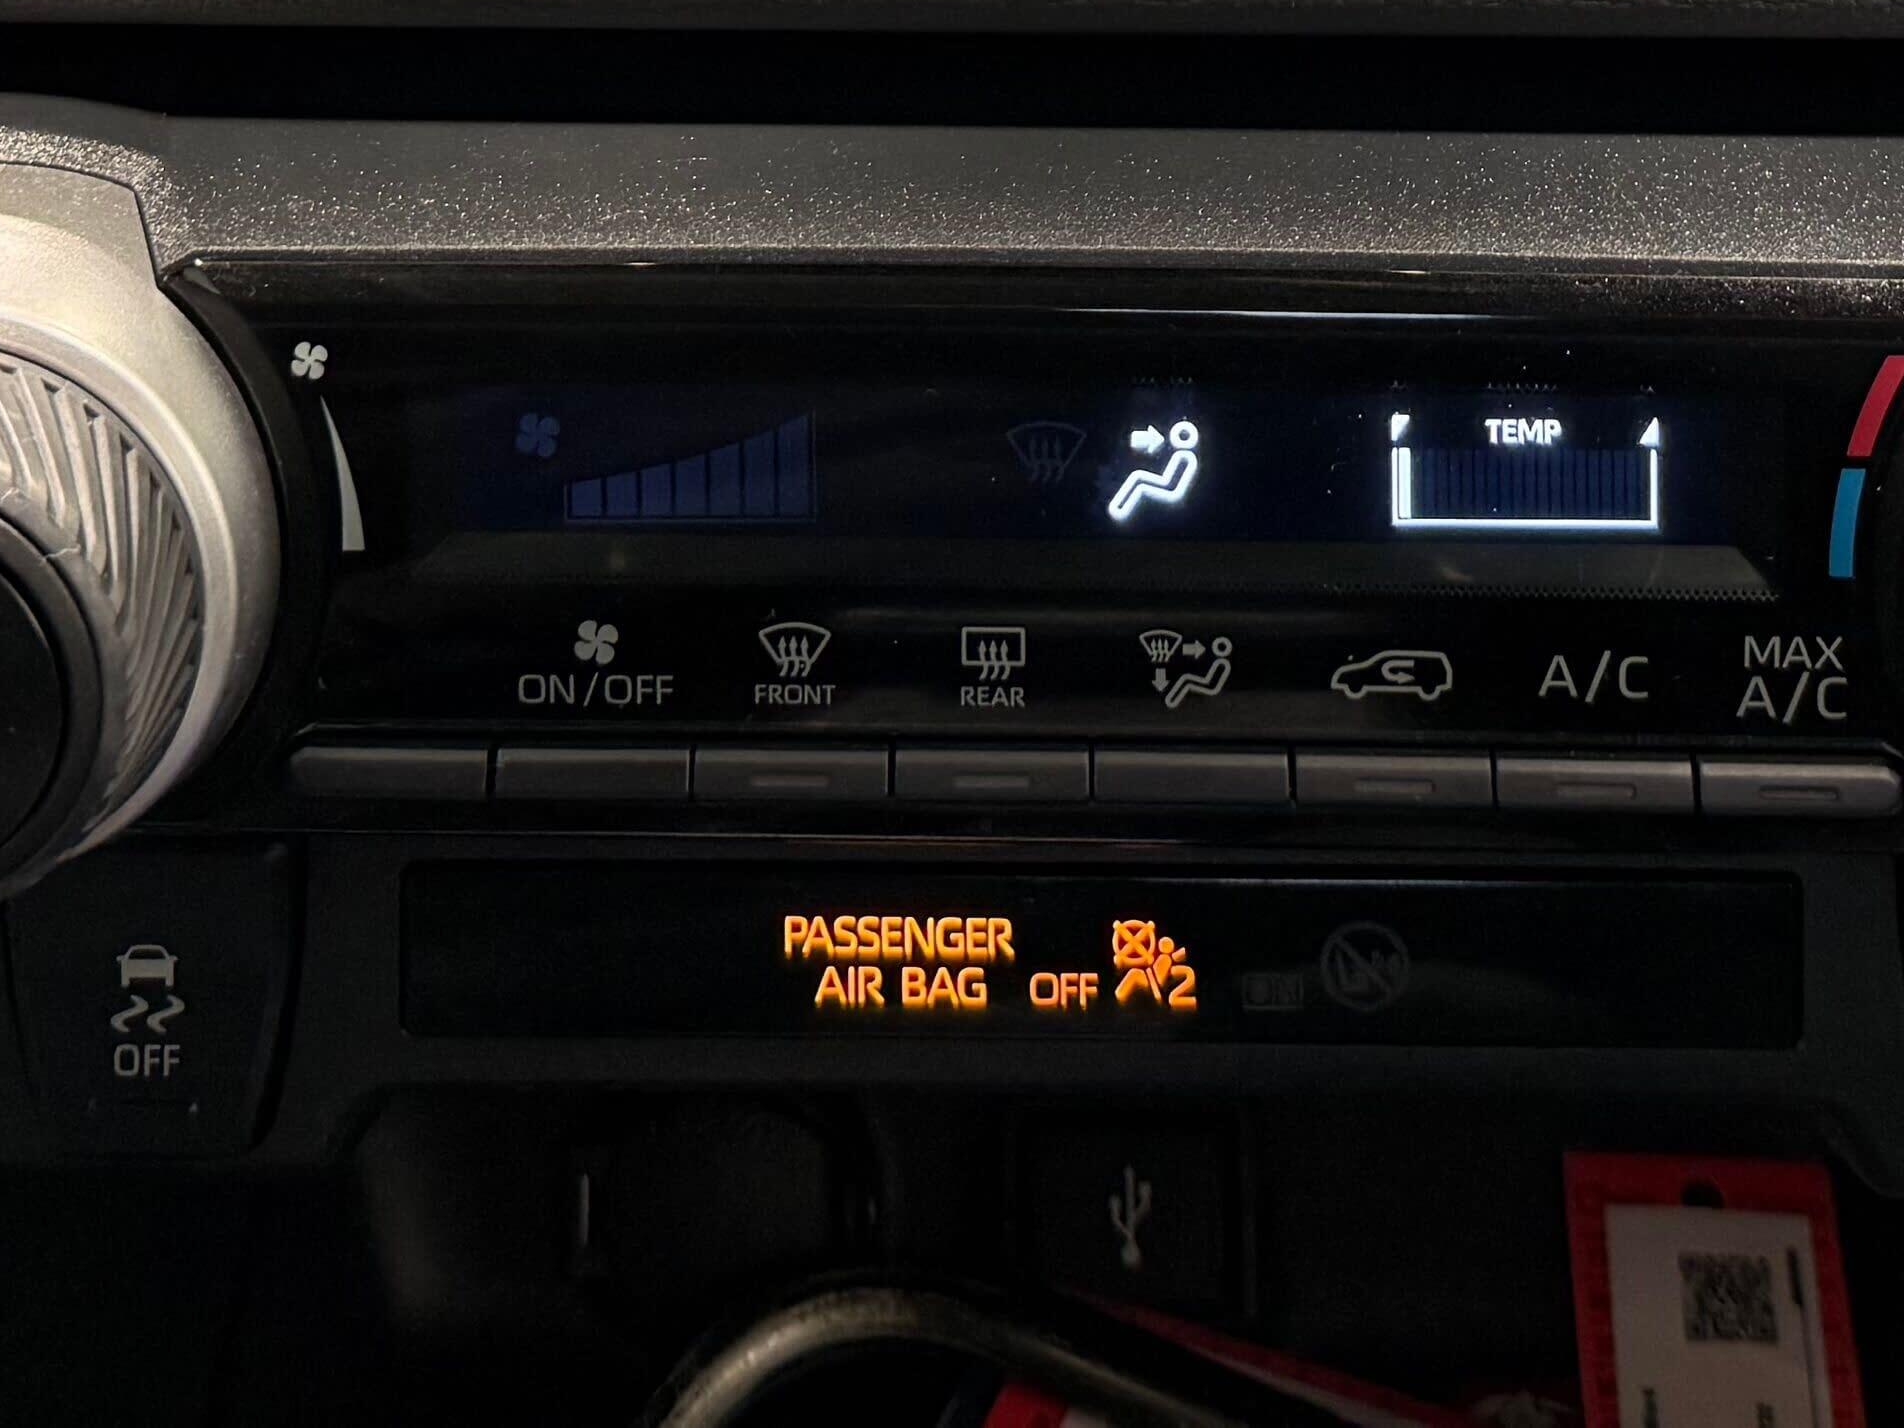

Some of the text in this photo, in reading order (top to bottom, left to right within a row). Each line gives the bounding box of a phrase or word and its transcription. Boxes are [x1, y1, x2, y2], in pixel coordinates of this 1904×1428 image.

[1484, 417, 1563, 447] TEMP
[1743, 635, 1843, 671] MAX
[518, 671, 674, 707] ON/OFF
[754, 683, 836, 705] FRONT
[1538, 649, 1649, 703] A/C
[960, 686, 1026, 708] REAR
[1735, 670, 1848, 724] A/C
[784, 915, 1015, 961] PASSENGER
[814, 965, 885, 1008] AIR
[901, 966, 988, 1009] BAG
[1029, 972, 1099, 1011] OFF
[113, 1043, 181, 1077] OFF
